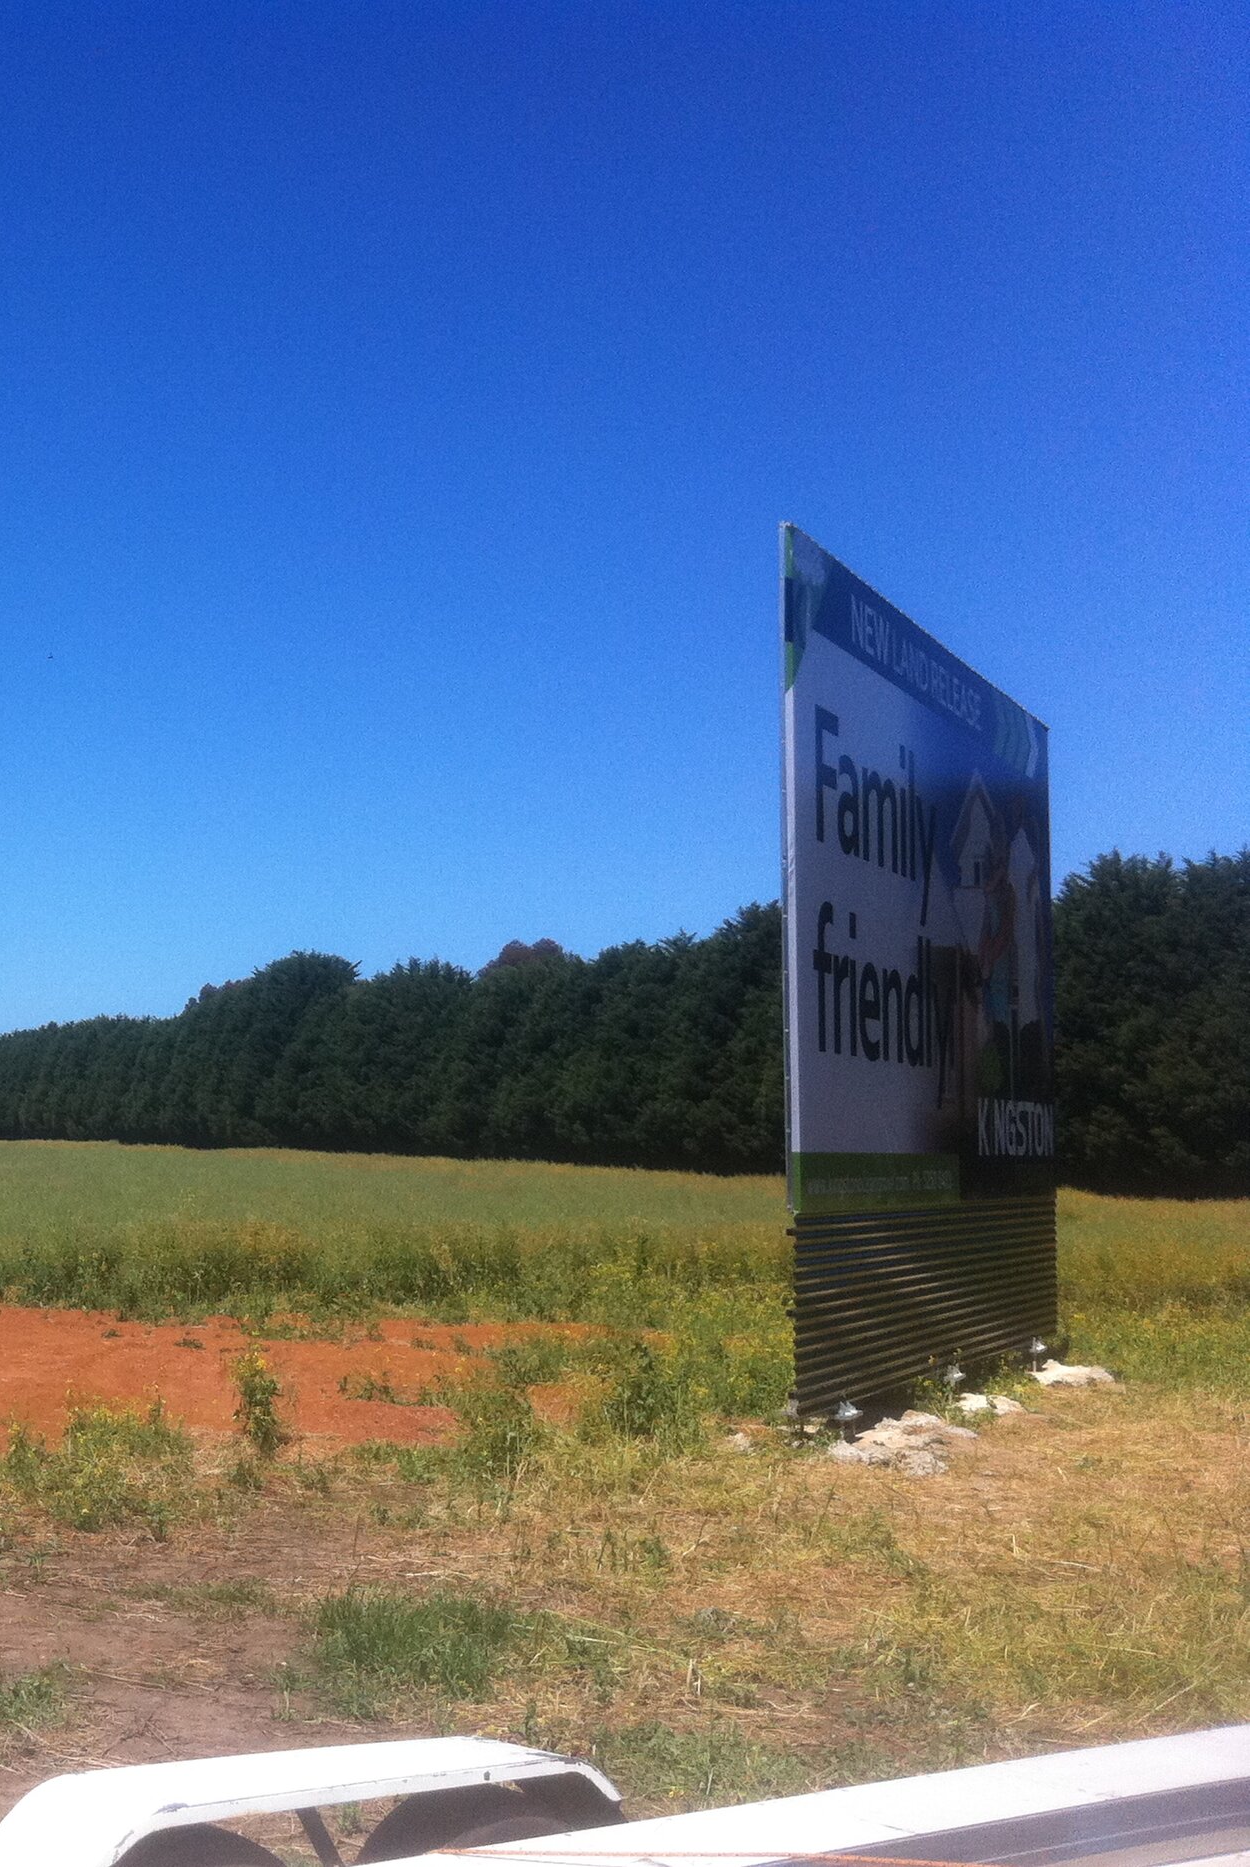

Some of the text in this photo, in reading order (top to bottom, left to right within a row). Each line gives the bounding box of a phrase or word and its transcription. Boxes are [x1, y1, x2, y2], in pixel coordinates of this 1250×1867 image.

[851, 593, 889, 665] NEW
[815, 703, 938, 927] Family
[813, 900, 956, 1110] friendly
[978, 1098, 1054, 1157] KNGSTON
